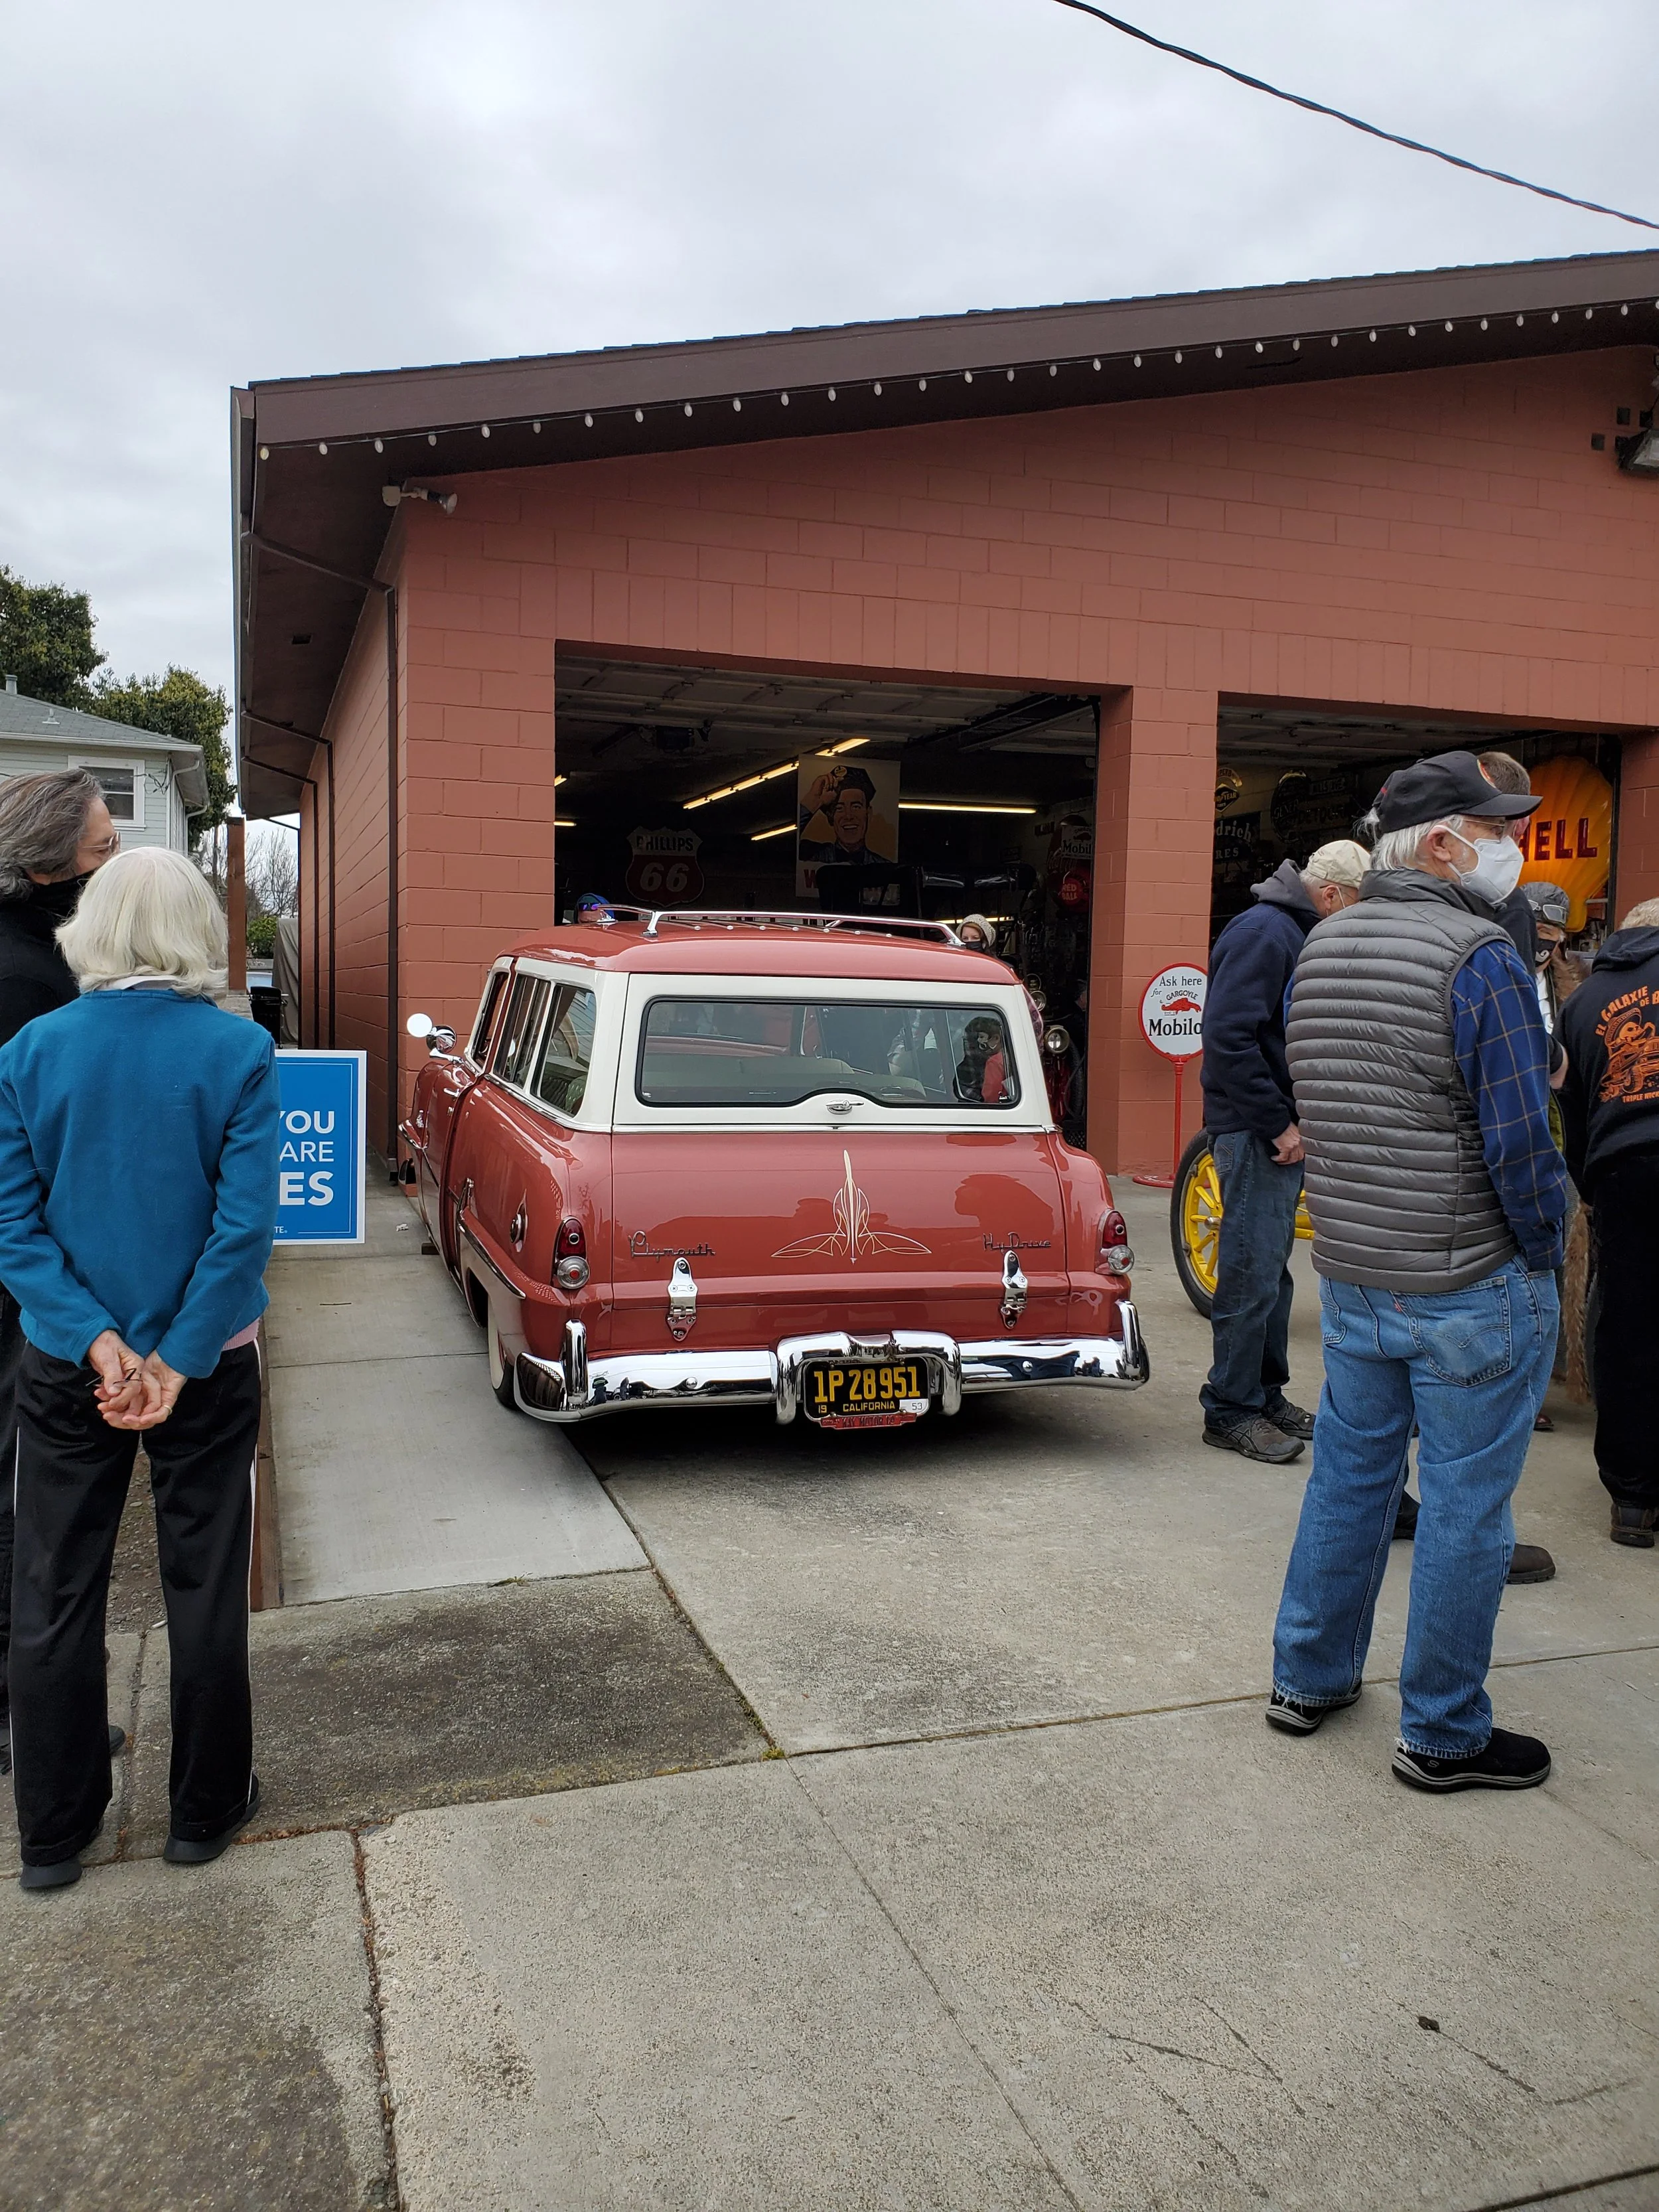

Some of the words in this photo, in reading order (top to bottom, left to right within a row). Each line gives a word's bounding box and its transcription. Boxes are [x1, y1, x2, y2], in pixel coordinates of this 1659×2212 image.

[636, 836, 693, 851] PHILLIPS
[640, 861, 690, 892] 66
[1159, 976, 1177, 986] Ask
[1181, 976, 1202, 986] here
[1151, 988, 1162, 997] for
[1166, 990, 1198, 1001] GARGOYLE
[628, 1230, 716, 1262] Plymouth
[818, 1405, 828, 1414] 19
[843, 1401, 895, 1412] CALIFORNIA
